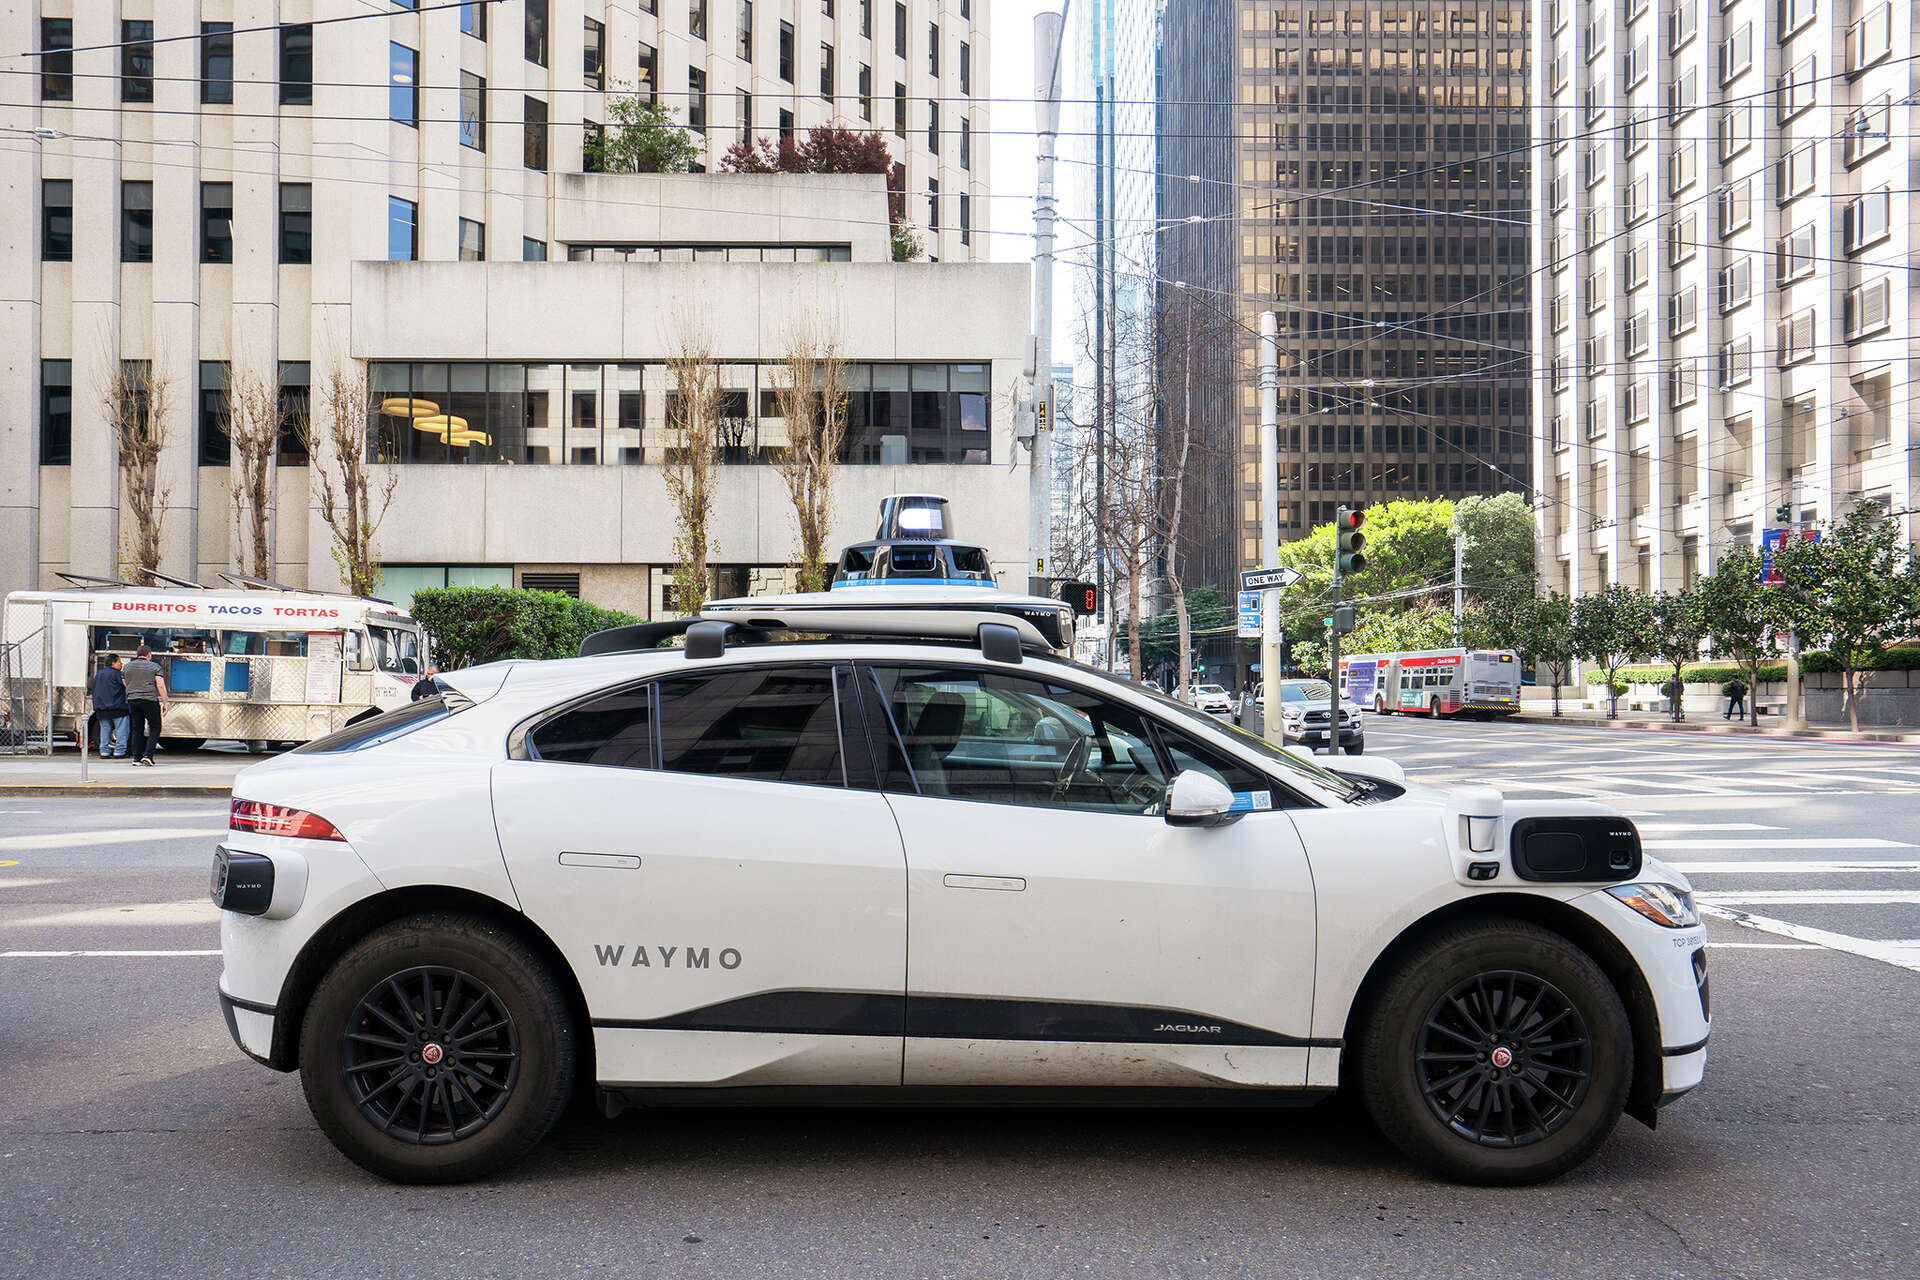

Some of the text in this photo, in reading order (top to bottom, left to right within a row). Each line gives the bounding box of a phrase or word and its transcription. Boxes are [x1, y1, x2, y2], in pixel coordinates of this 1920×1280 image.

[1247, 574, 1284, 585] ONE WAY
[112, 602, 339, 618] BURRITOS TACOS TORTAS
[594, 944, 742, 970] WAYMO
[1152, 1024, 1222, 1033] JAGUAR
